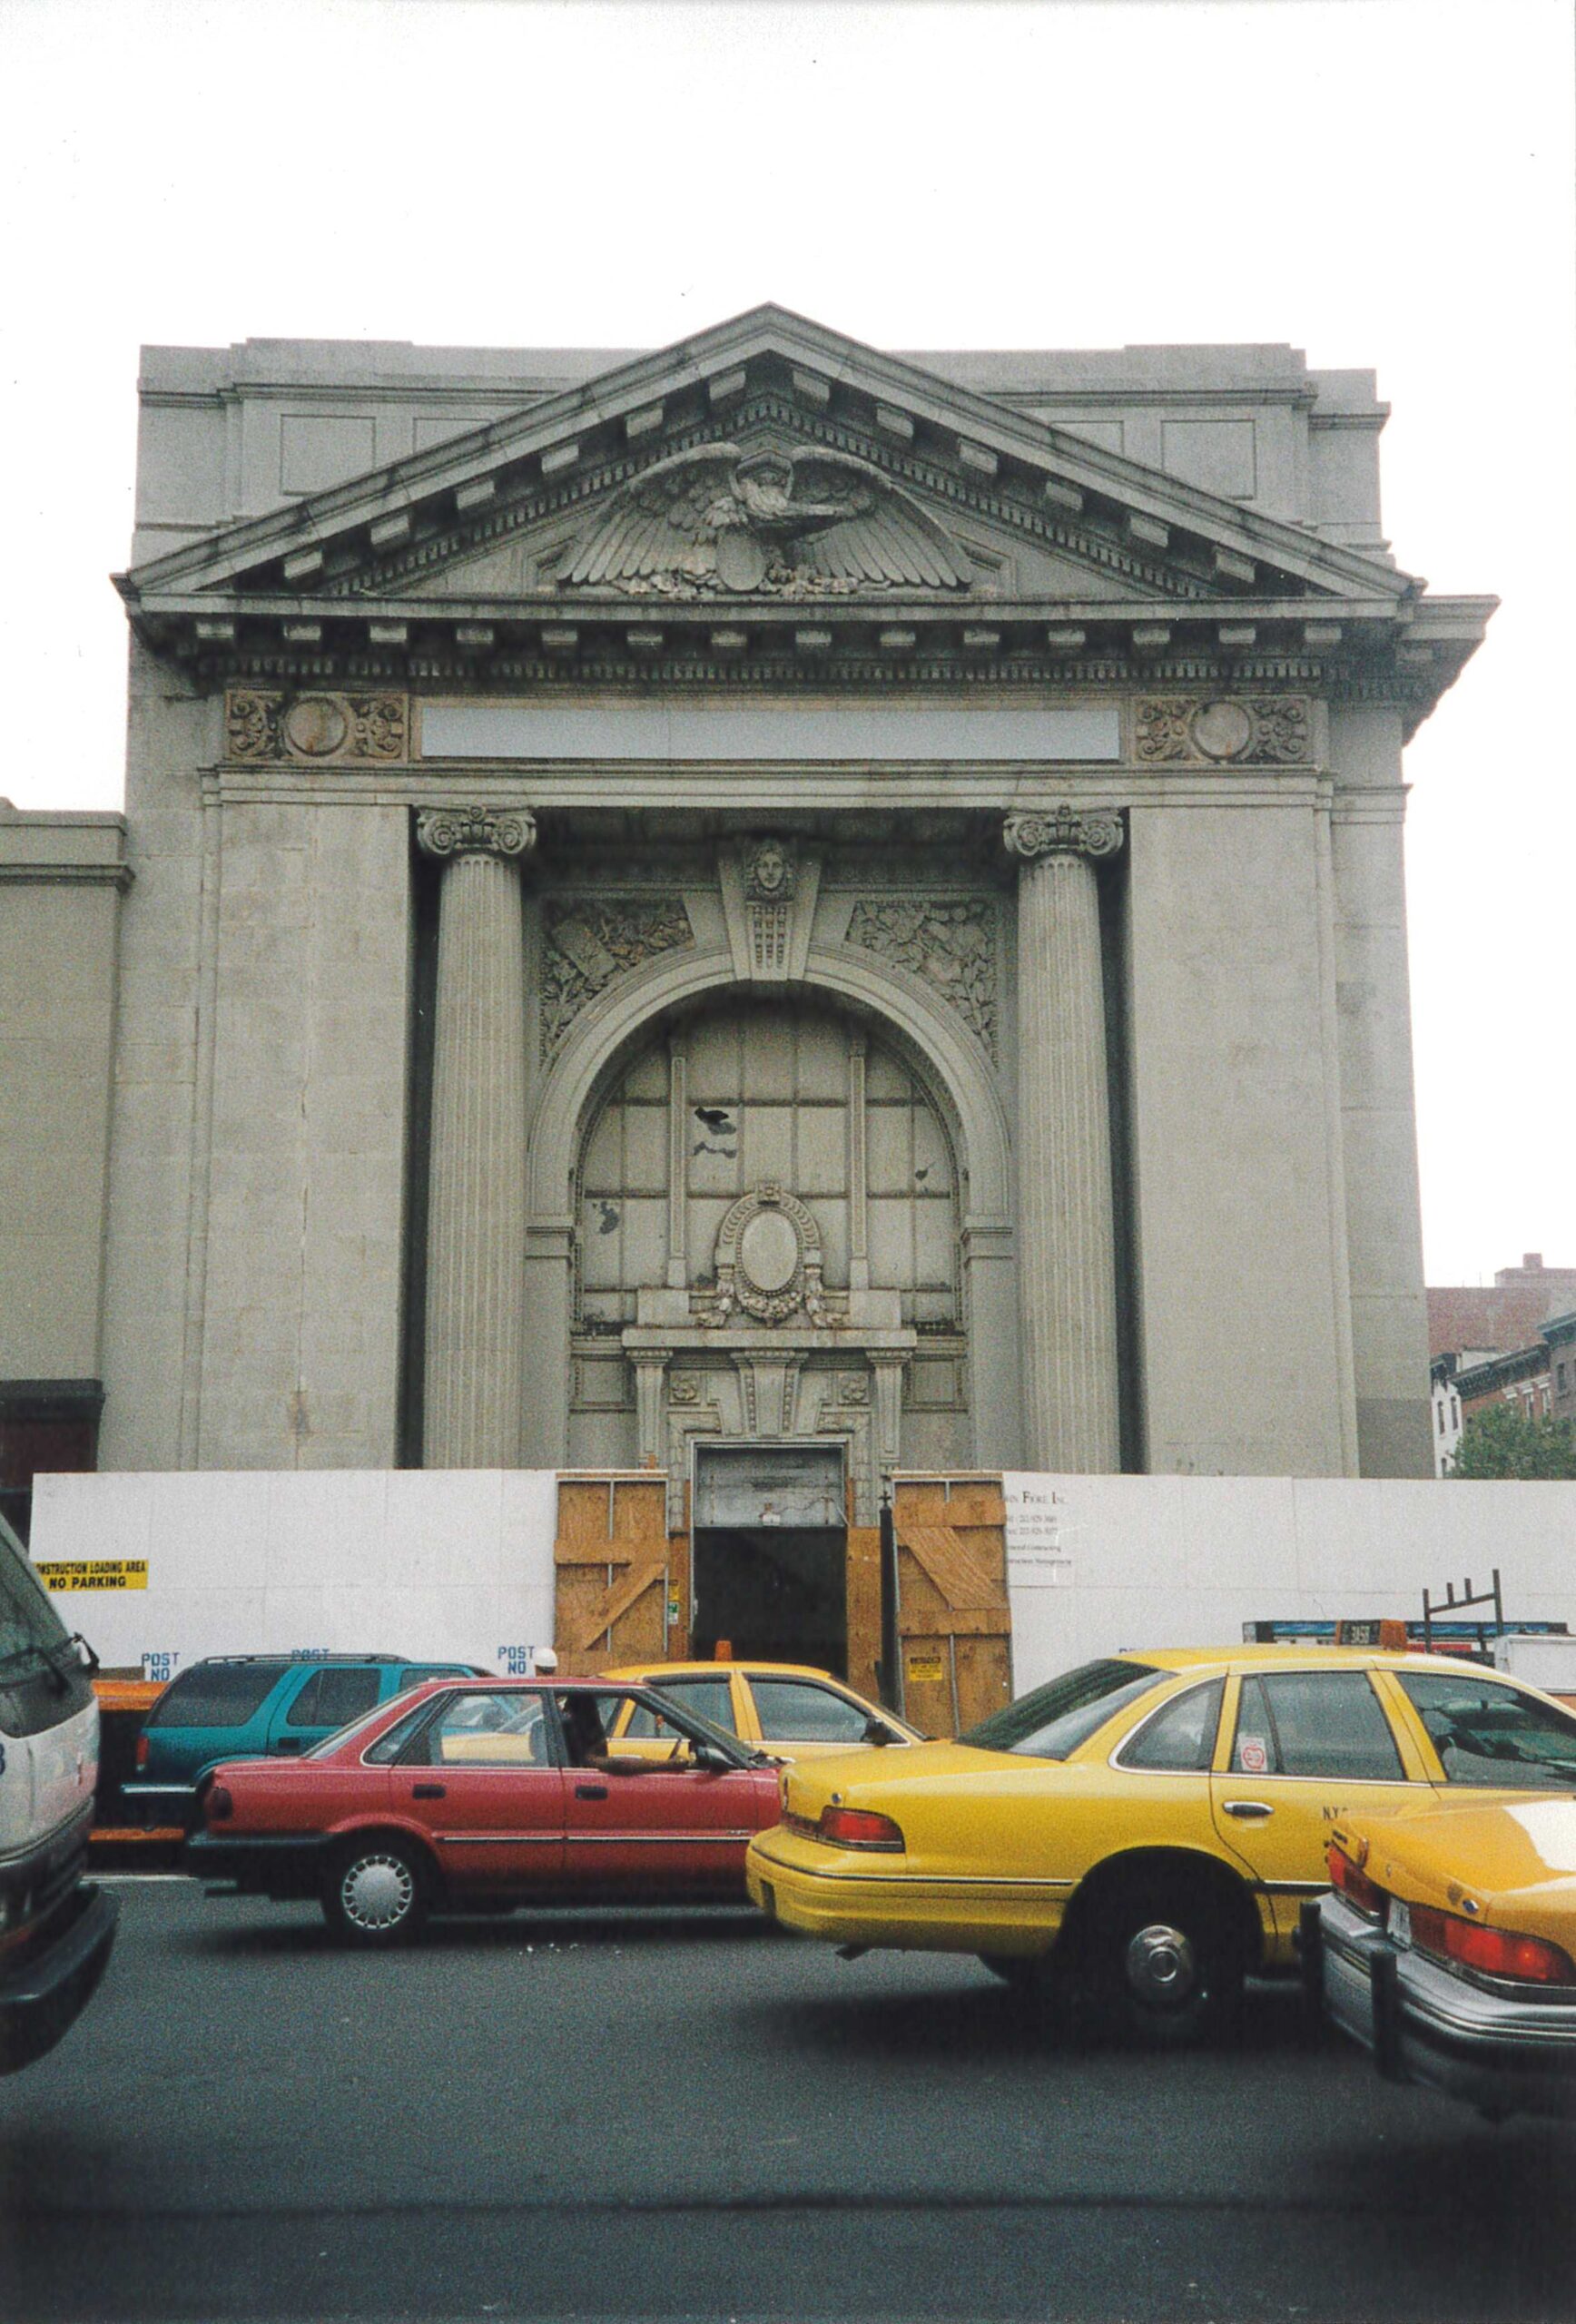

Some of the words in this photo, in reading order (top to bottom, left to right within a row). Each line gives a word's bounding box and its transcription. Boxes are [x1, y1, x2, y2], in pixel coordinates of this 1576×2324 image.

[90, 1561, 123, 1574] LOADING
[125, 1560, 145, 1572] AREA
[49, 1577, 66, 1590] NO
[72, 1576, 126, 1589] PARKING
[141, 1652, 181, 1667] POST
[497, 1646, 535, 1659] POST
[151, 1667, 170, 1681] NO
[507, 1660, 527, 1675] NO
